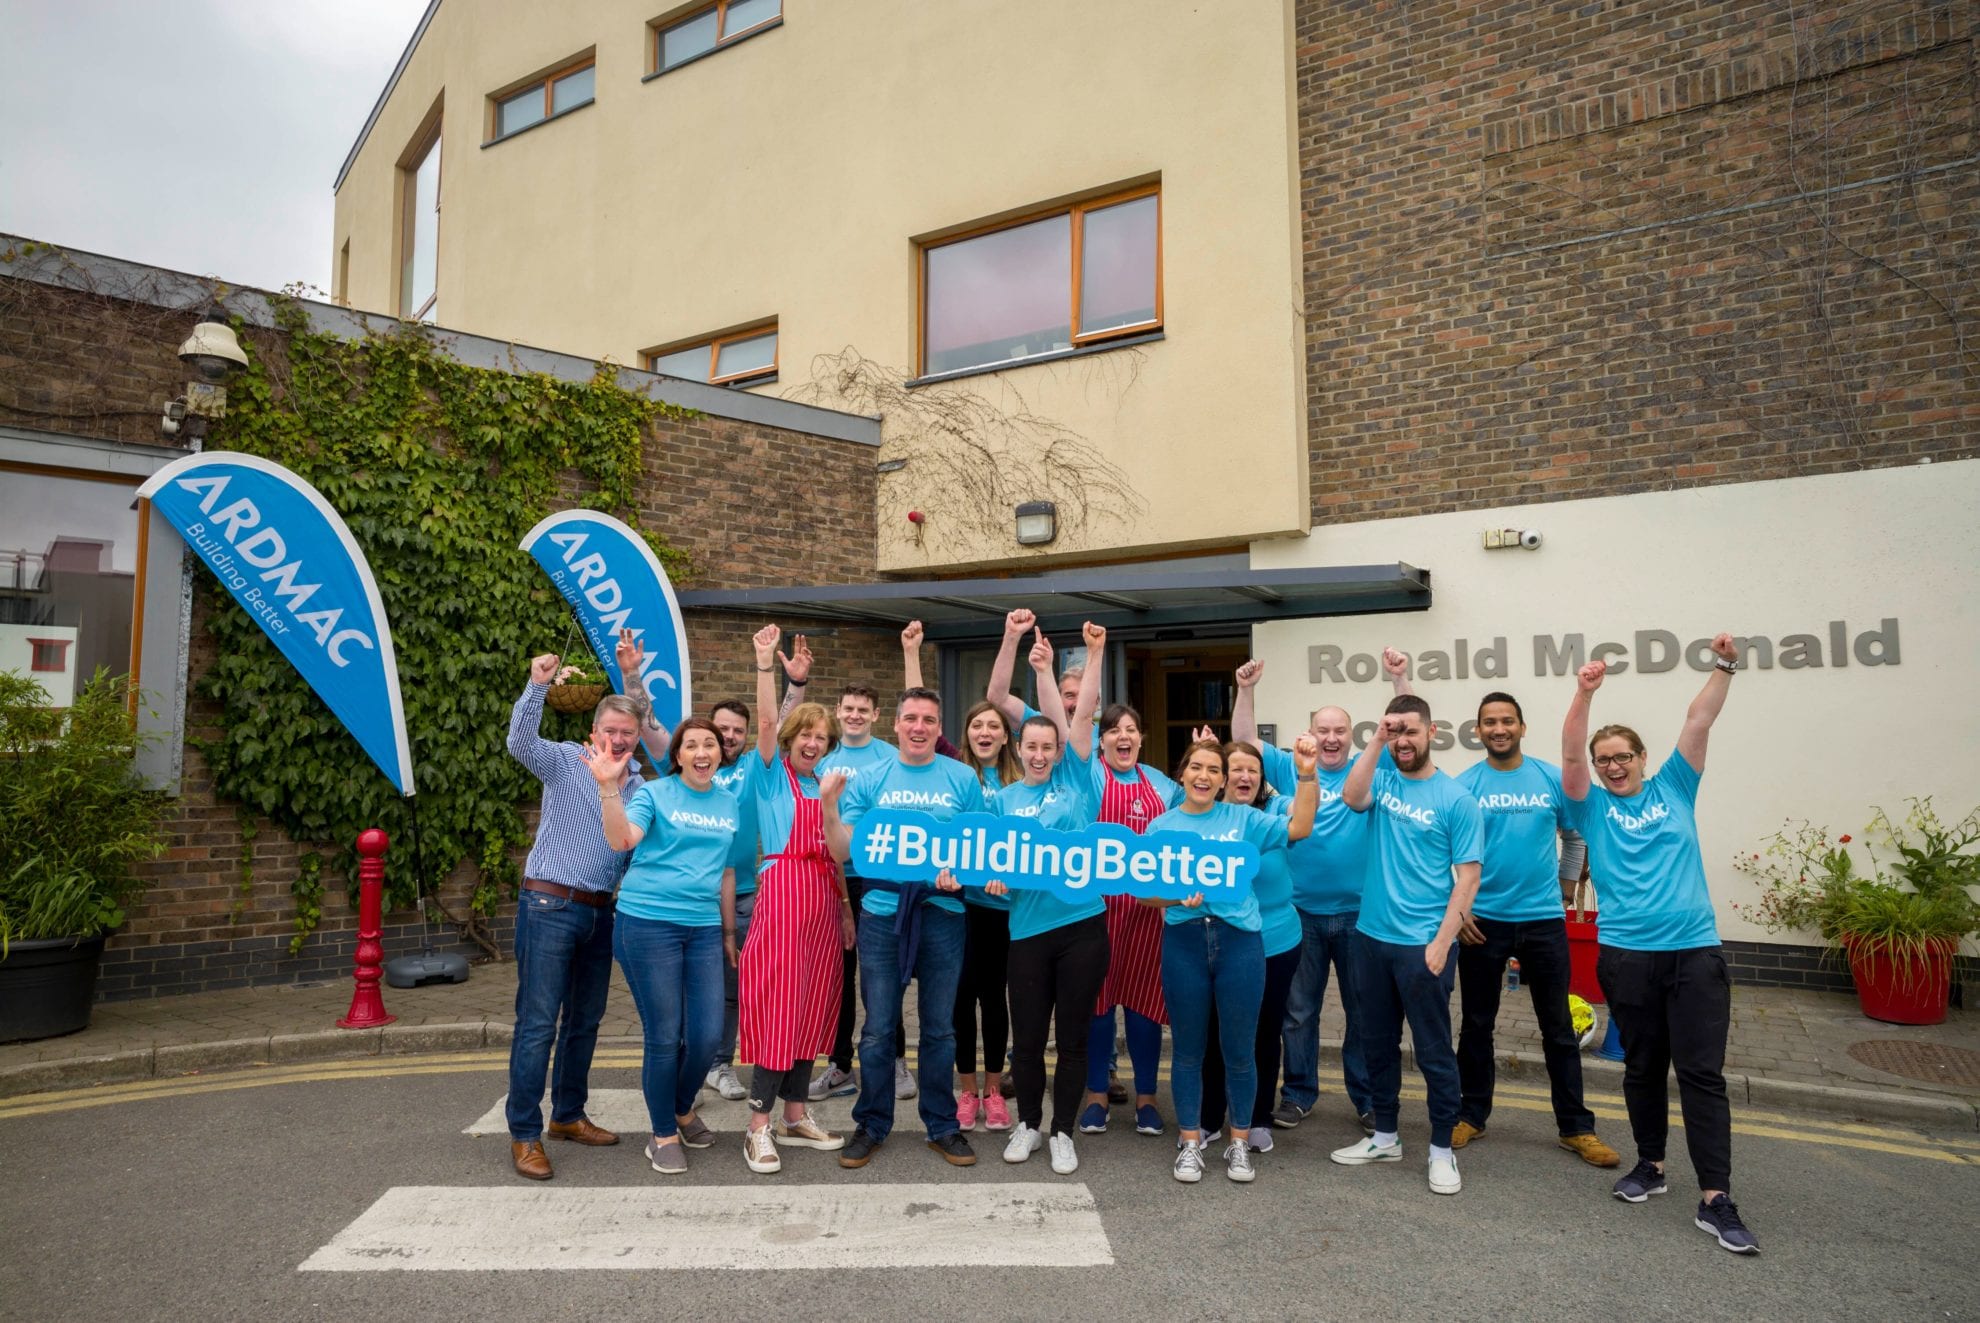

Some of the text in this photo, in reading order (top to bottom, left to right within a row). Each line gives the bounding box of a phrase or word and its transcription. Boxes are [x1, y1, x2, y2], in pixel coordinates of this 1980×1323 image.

[175, 475, 374, 668] ARDMAC
[186, 522, 291, 635] Building Better
[1533, 617, 1901, 677] McDonald
[1310, 711, 1489, 752] ose
[670, 809, 737, 832] ARDMAC
[878, 790, 952, 807] ARDMAC
[1478, 793, 1551, 808] ARDMAC
[864, 823, 1246, 889] #BuildingBetter
